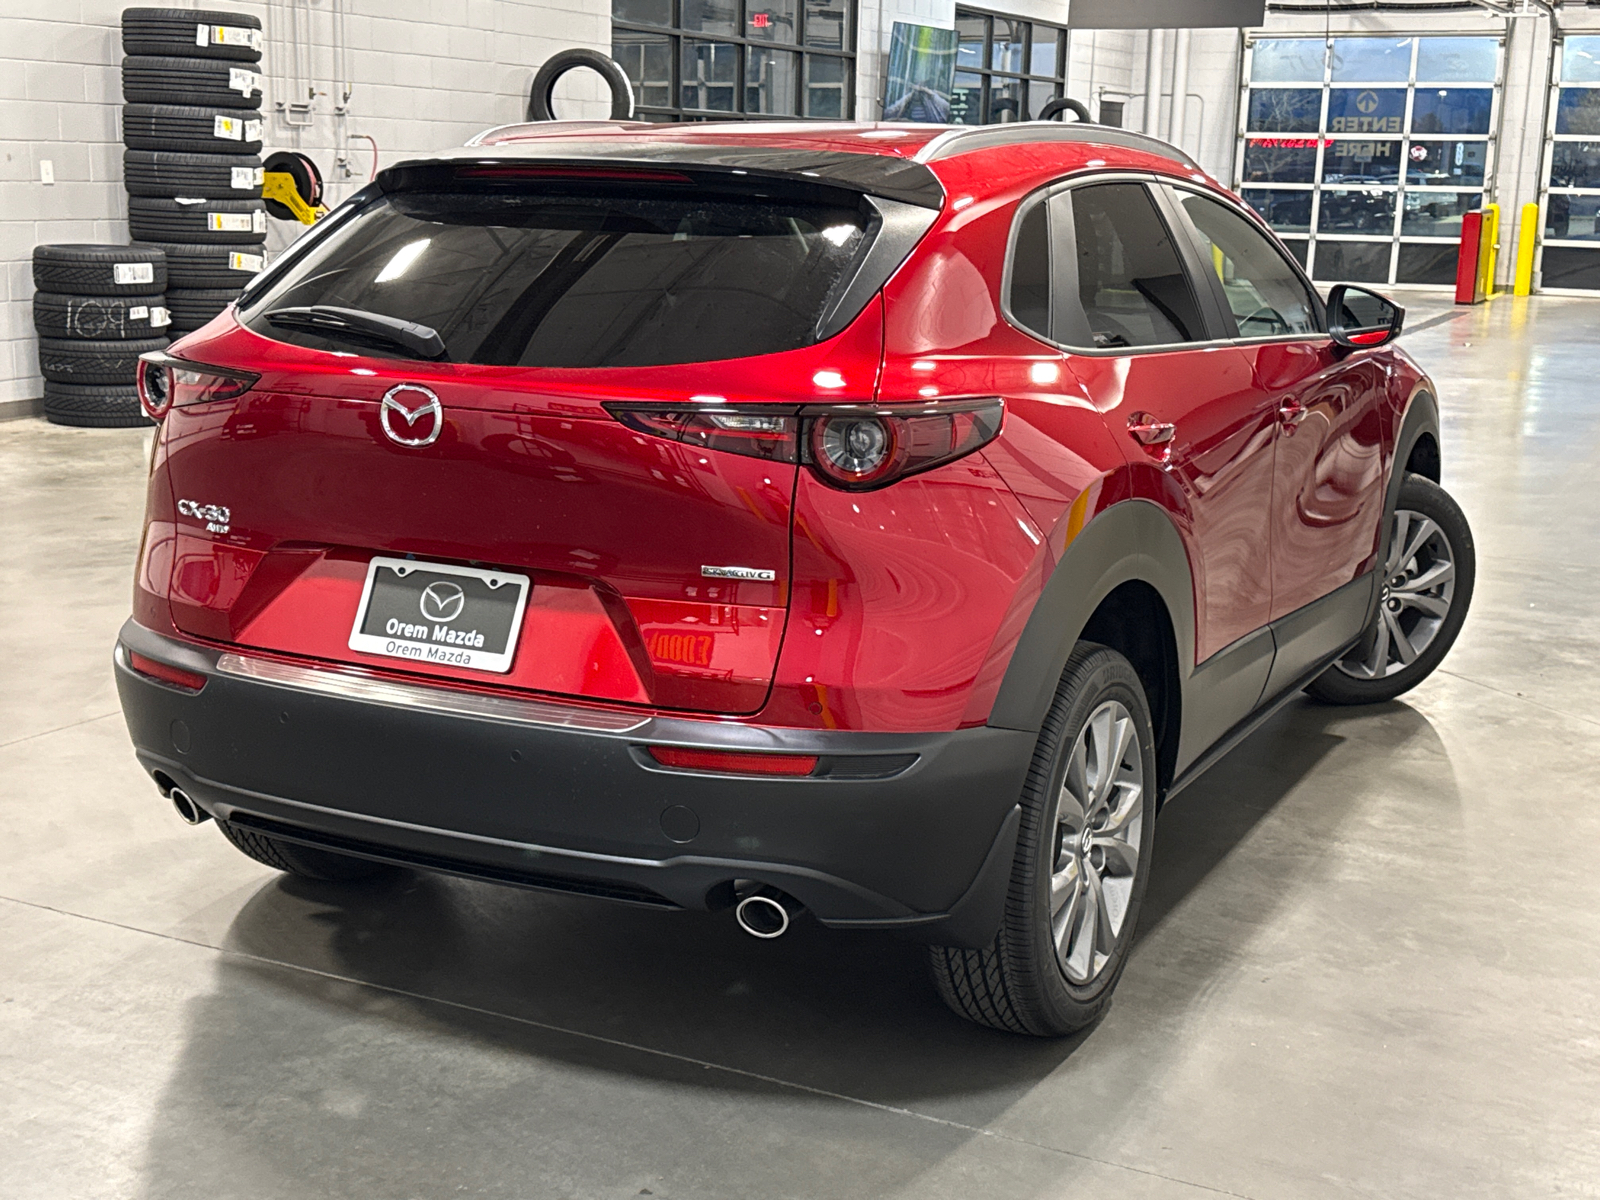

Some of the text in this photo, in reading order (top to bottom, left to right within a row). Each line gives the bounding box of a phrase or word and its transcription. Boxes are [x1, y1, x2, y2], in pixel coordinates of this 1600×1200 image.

[178, 499, 230, 523] CX-30
[386, 618, 485, 648] Orem Mazda
[386, 641, 471, 664] Orem Mazda
